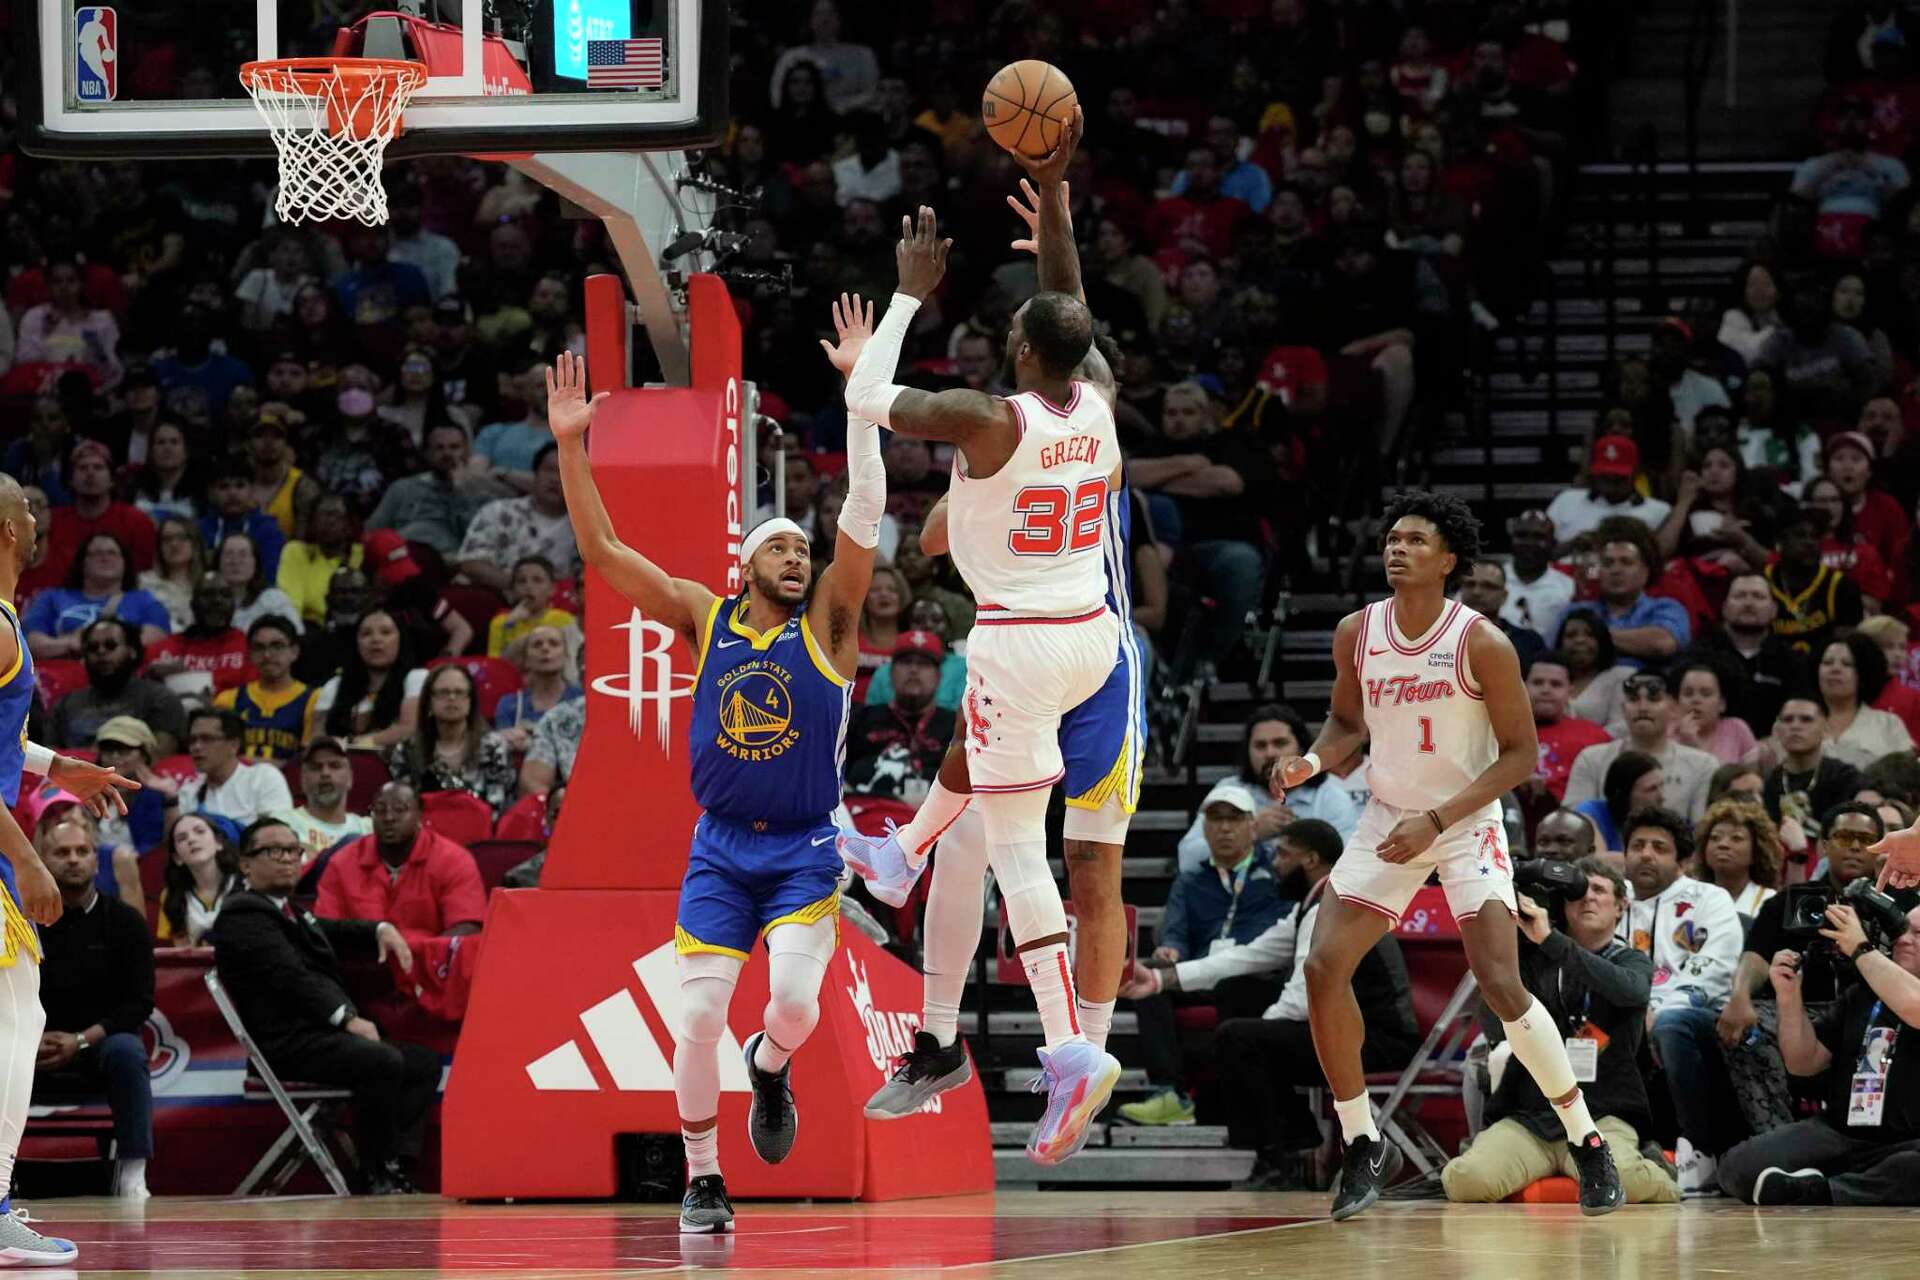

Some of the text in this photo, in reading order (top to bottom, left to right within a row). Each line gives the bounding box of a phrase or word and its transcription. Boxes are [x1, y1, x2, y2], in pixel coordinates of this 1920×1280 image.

[82, 80, 102, 96] NBA
[1041, 436, 1101, 469] GREEN
[726, 377, 741, 590] credit
[1008, 476, 1107, 556] 32
[763, 660, 793, 683] STATE
[1428, 660, 1454, 669] karma
[1429, 651, 1454, 660] credit
[765, 687, 779, 709] 4
[1367, 674, 1456, 708] H-Town
[716, 729, 800, 761] WARRIORS
[1418, 716, 1436, 754] 1
